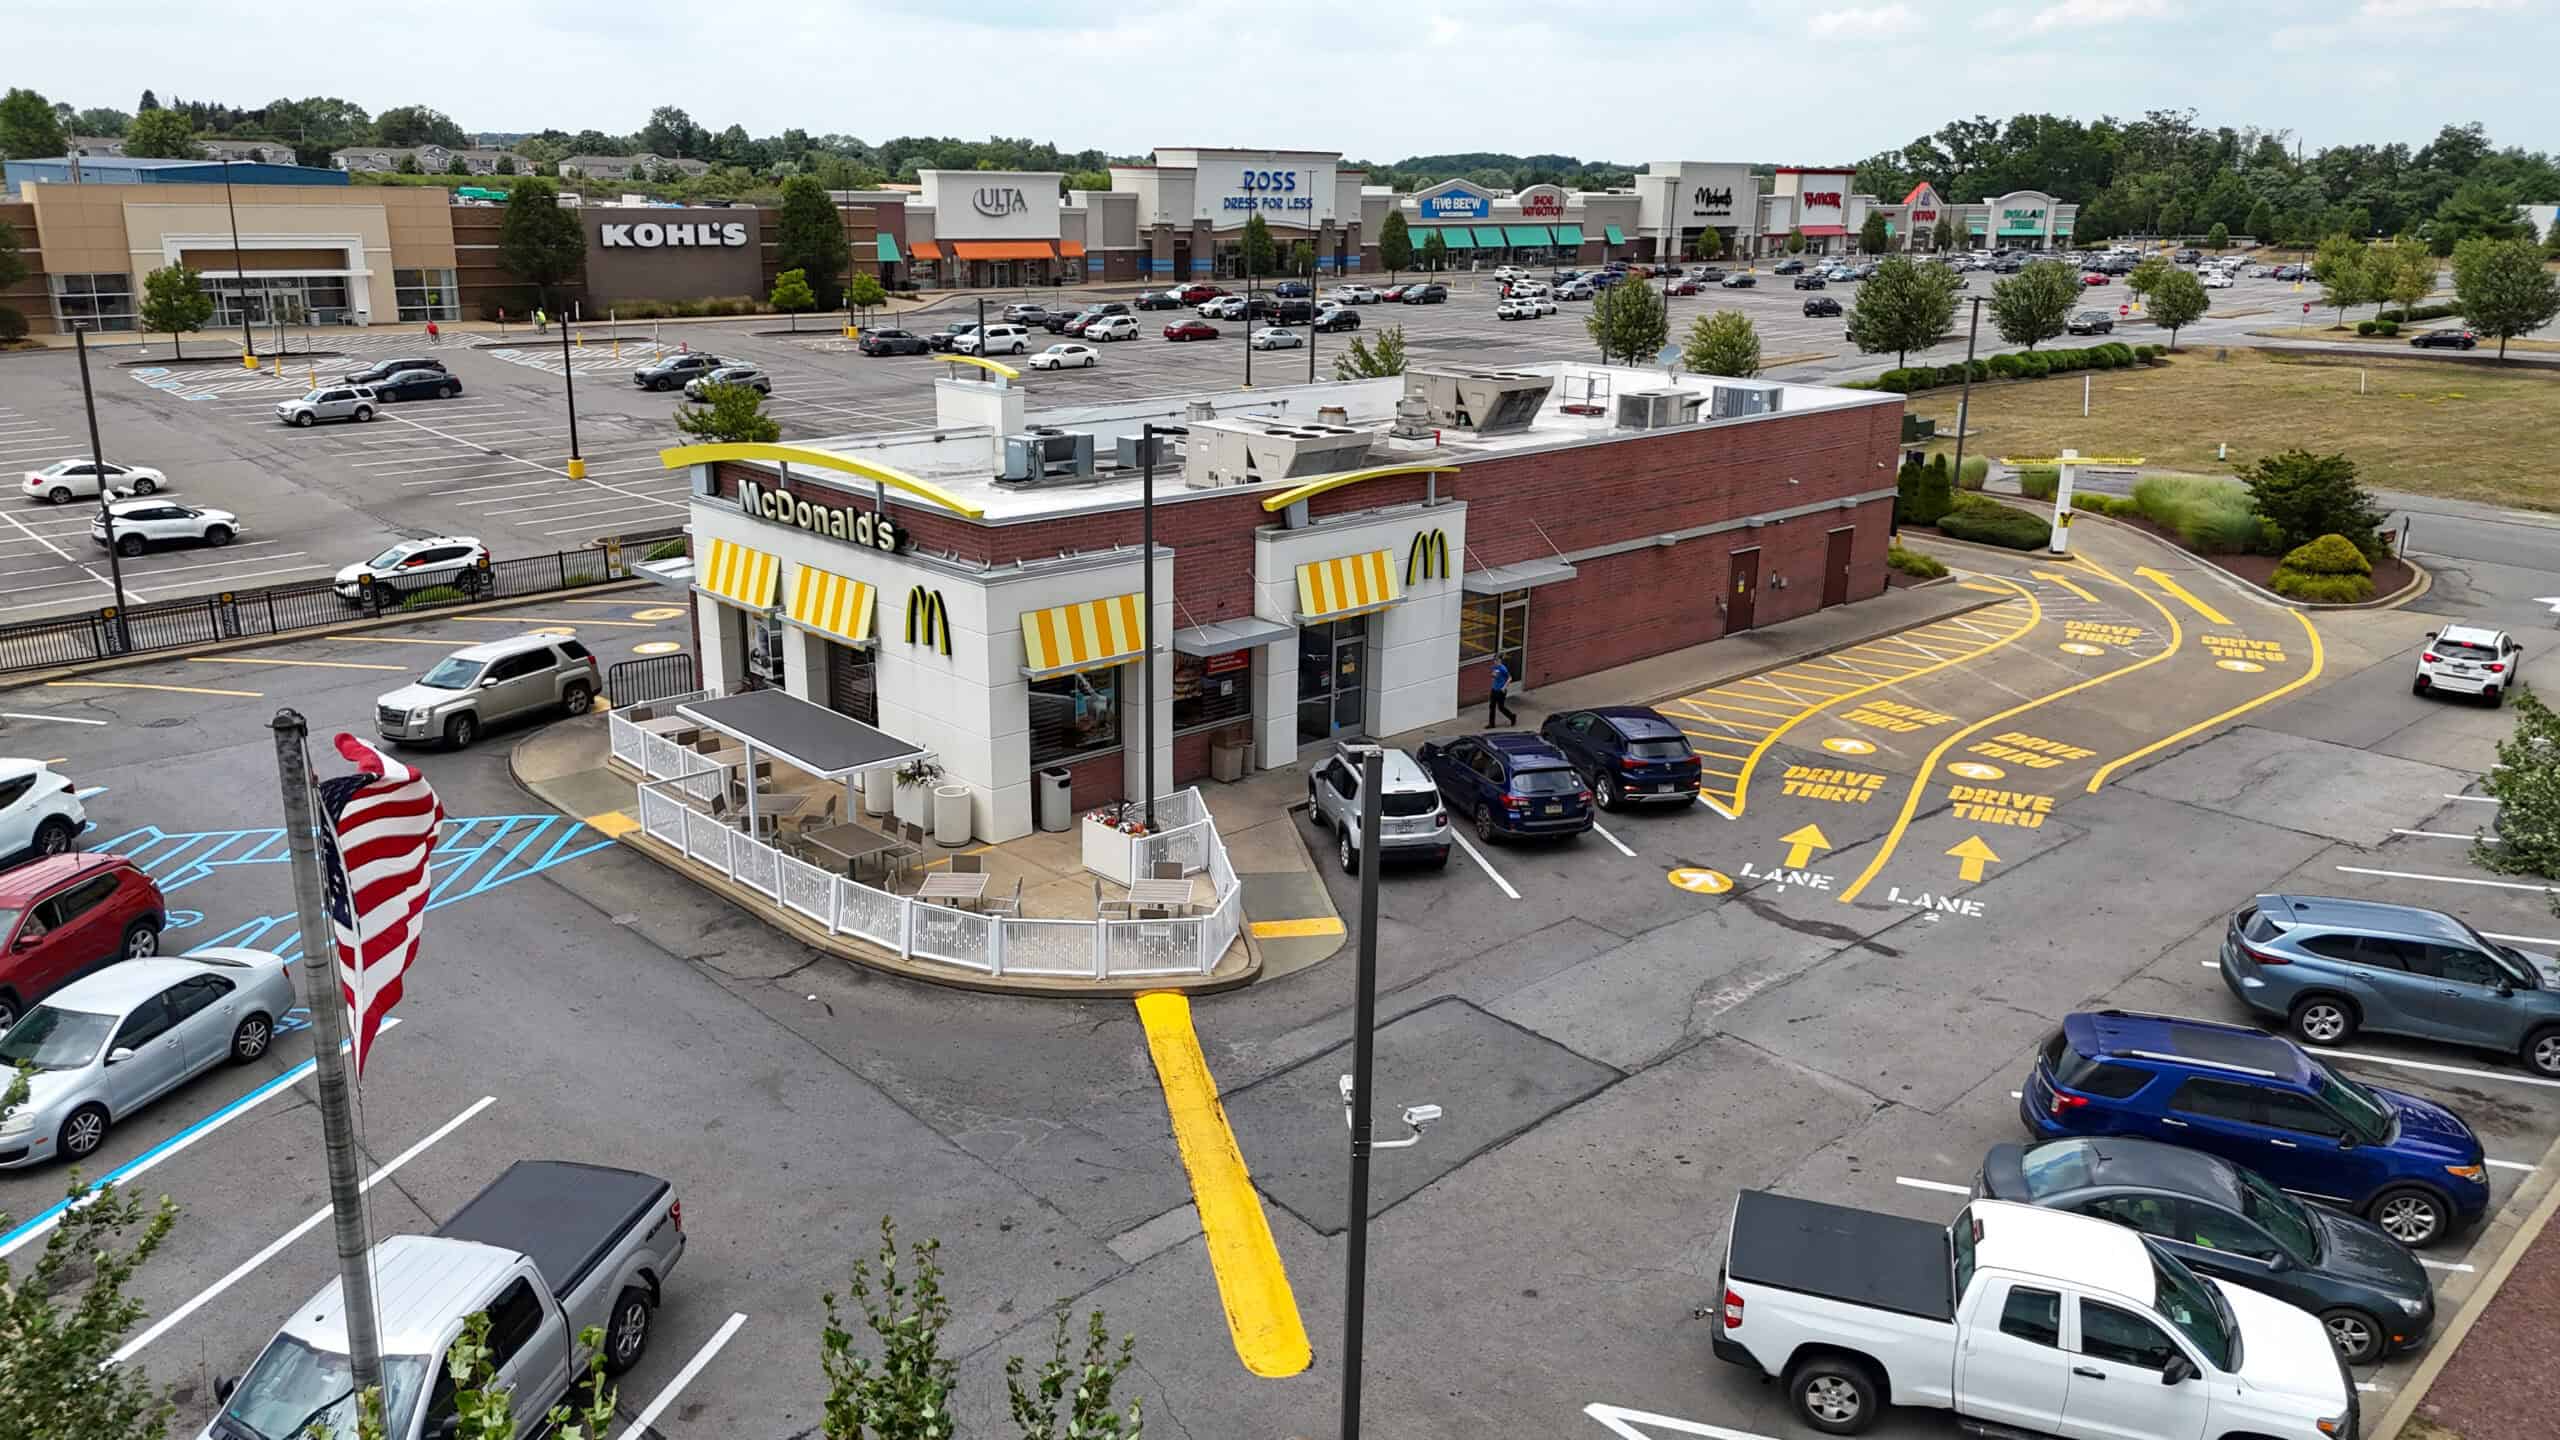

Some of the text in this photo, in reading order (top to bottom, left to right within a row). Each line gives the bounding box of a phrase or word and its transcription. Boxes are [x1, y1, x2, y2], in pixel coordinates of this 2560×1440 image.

[1243, 170, 1297, 192] ROSS
[975, 187, 1027, 214] ULTA
[1223, 197, 1313, 210] DRESS FOR LESS
[601, 222, 748, 247] KOHL'S
[738, 479, 896, 552] McDonald's
[2063, 619, 2142, 637] DRIVE
[2065, 630, 2135, 646] THRU
[2200, 635, 2281, 650] DRIVE
[2208, 646, 2287, 661] THRU
[1839, 709, 1928, 732] THRU
[1858, 700, 1954, 726] DRIVE
[1966, 741, 2065, 768] THRU
[1991, 731, 2097, 760] DRIVE
[1782, 765, 1887, 790] DRIVE
[1781, 780, 1874, 803] THRU
[1948, 785, 2056, 813] DRIVE
[1951, 802, 2047, 828] THRU
[1739, 862, 1835, 890] LANE
[1887, 887, 1985, 918] LANE
